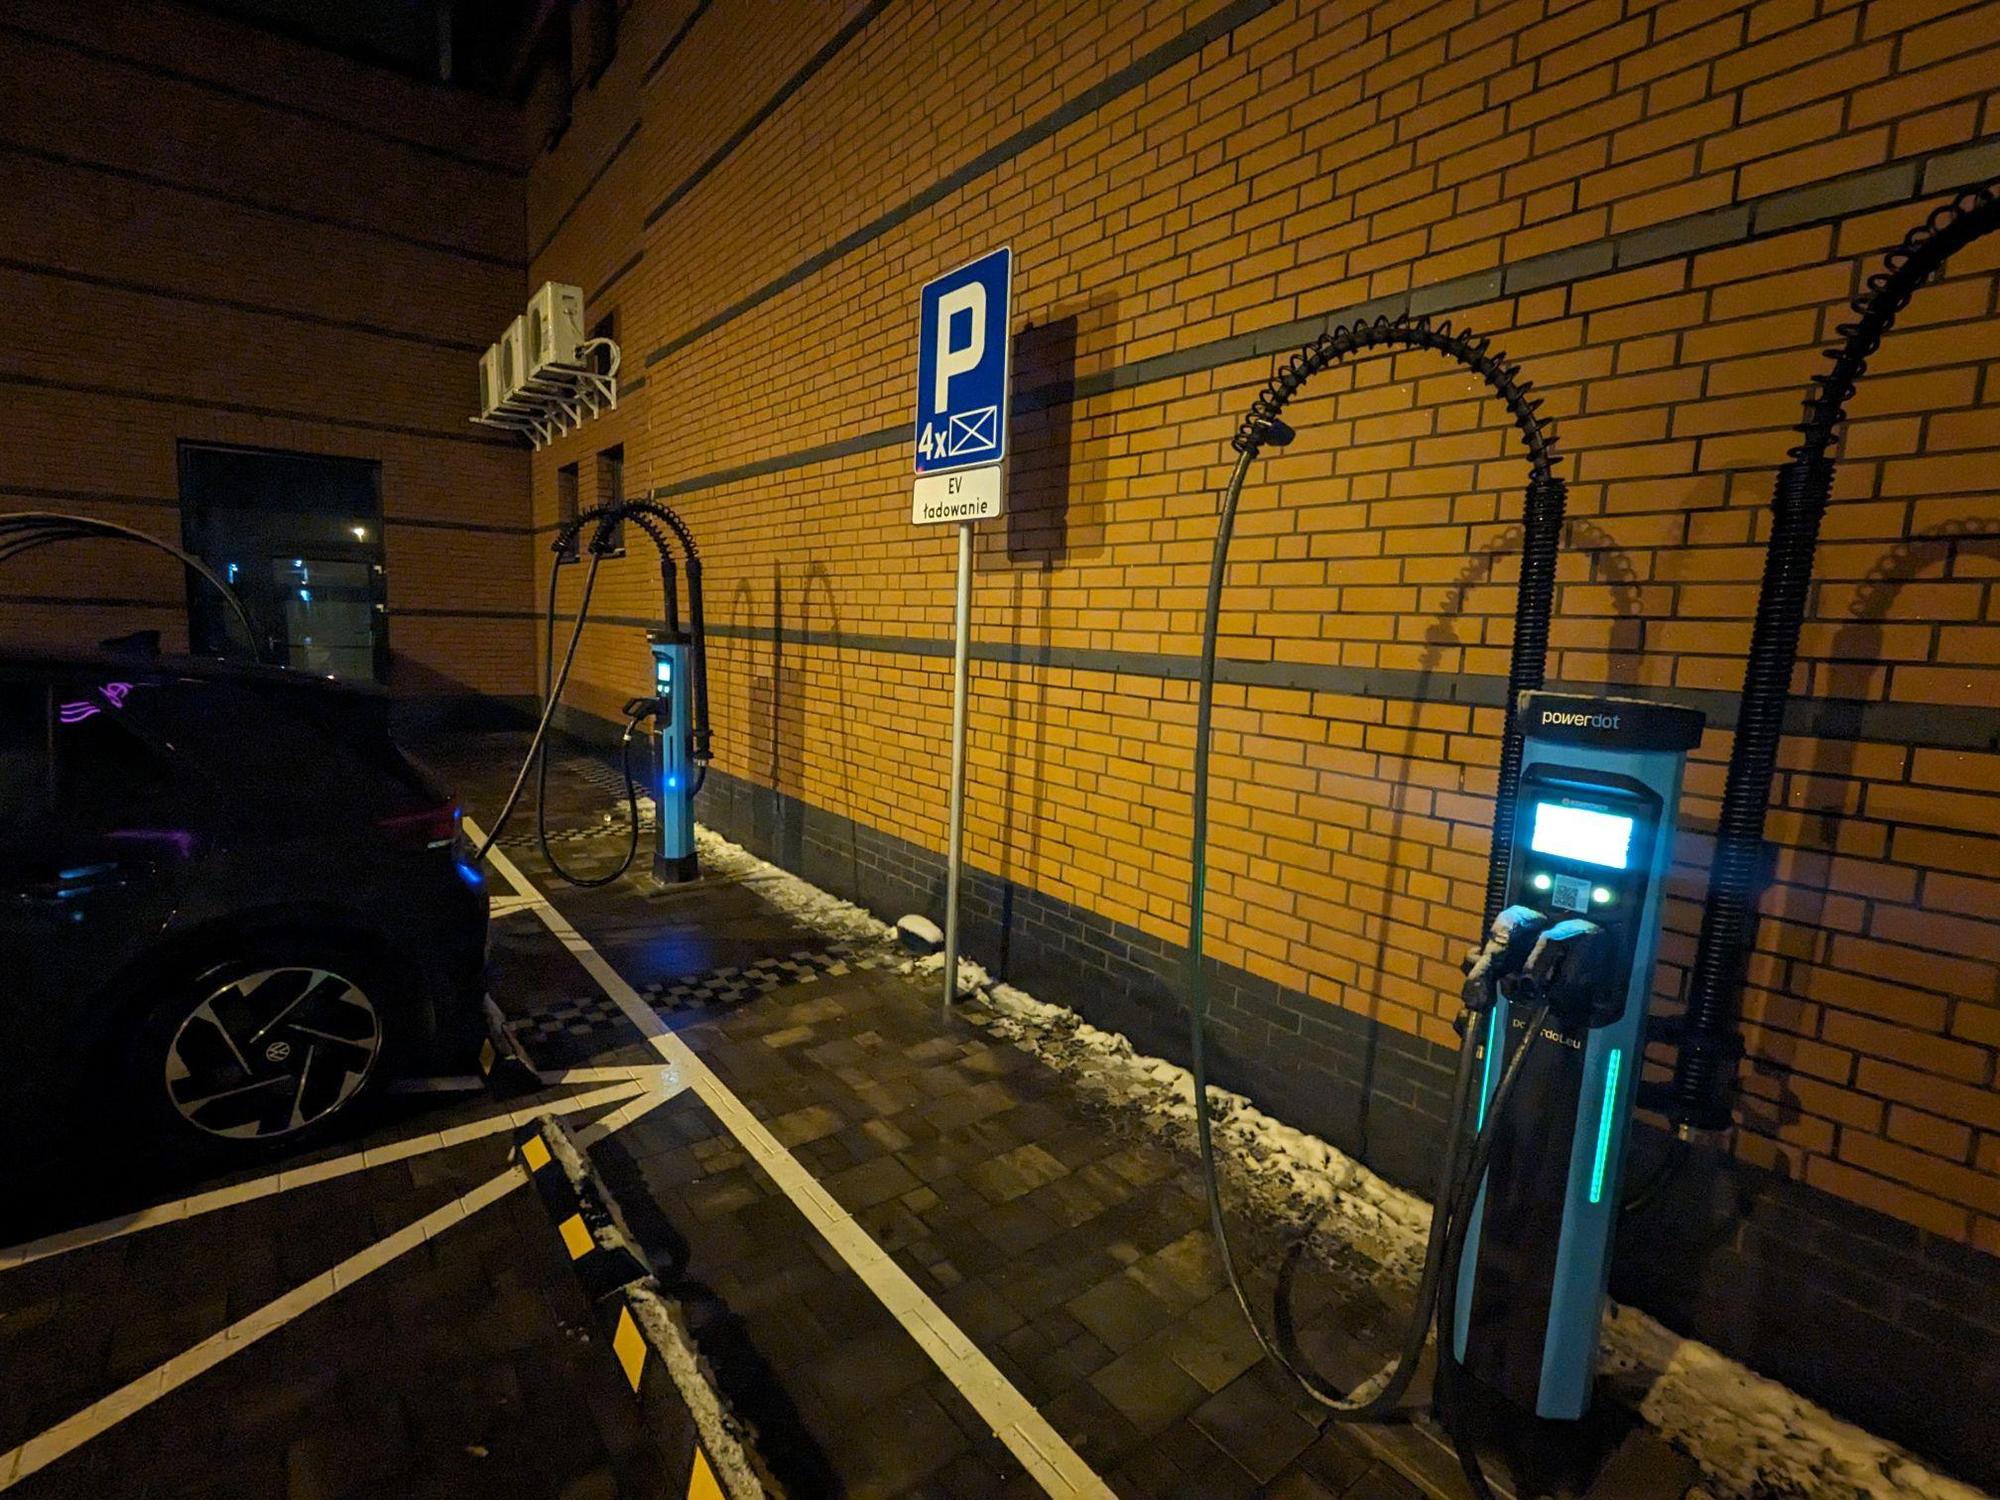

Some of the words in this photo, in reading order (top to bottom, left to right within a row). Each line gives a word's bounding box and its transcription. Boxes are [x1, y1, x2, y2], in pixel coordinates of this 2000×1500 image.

[935, 281, 987, 415] P
[918, 422, 947, 460] 4x
[948, 477, 963, 494] EV
[923, 497, 988, 520] ładowanie
[1541, 711, 1621, 730] powerdot
